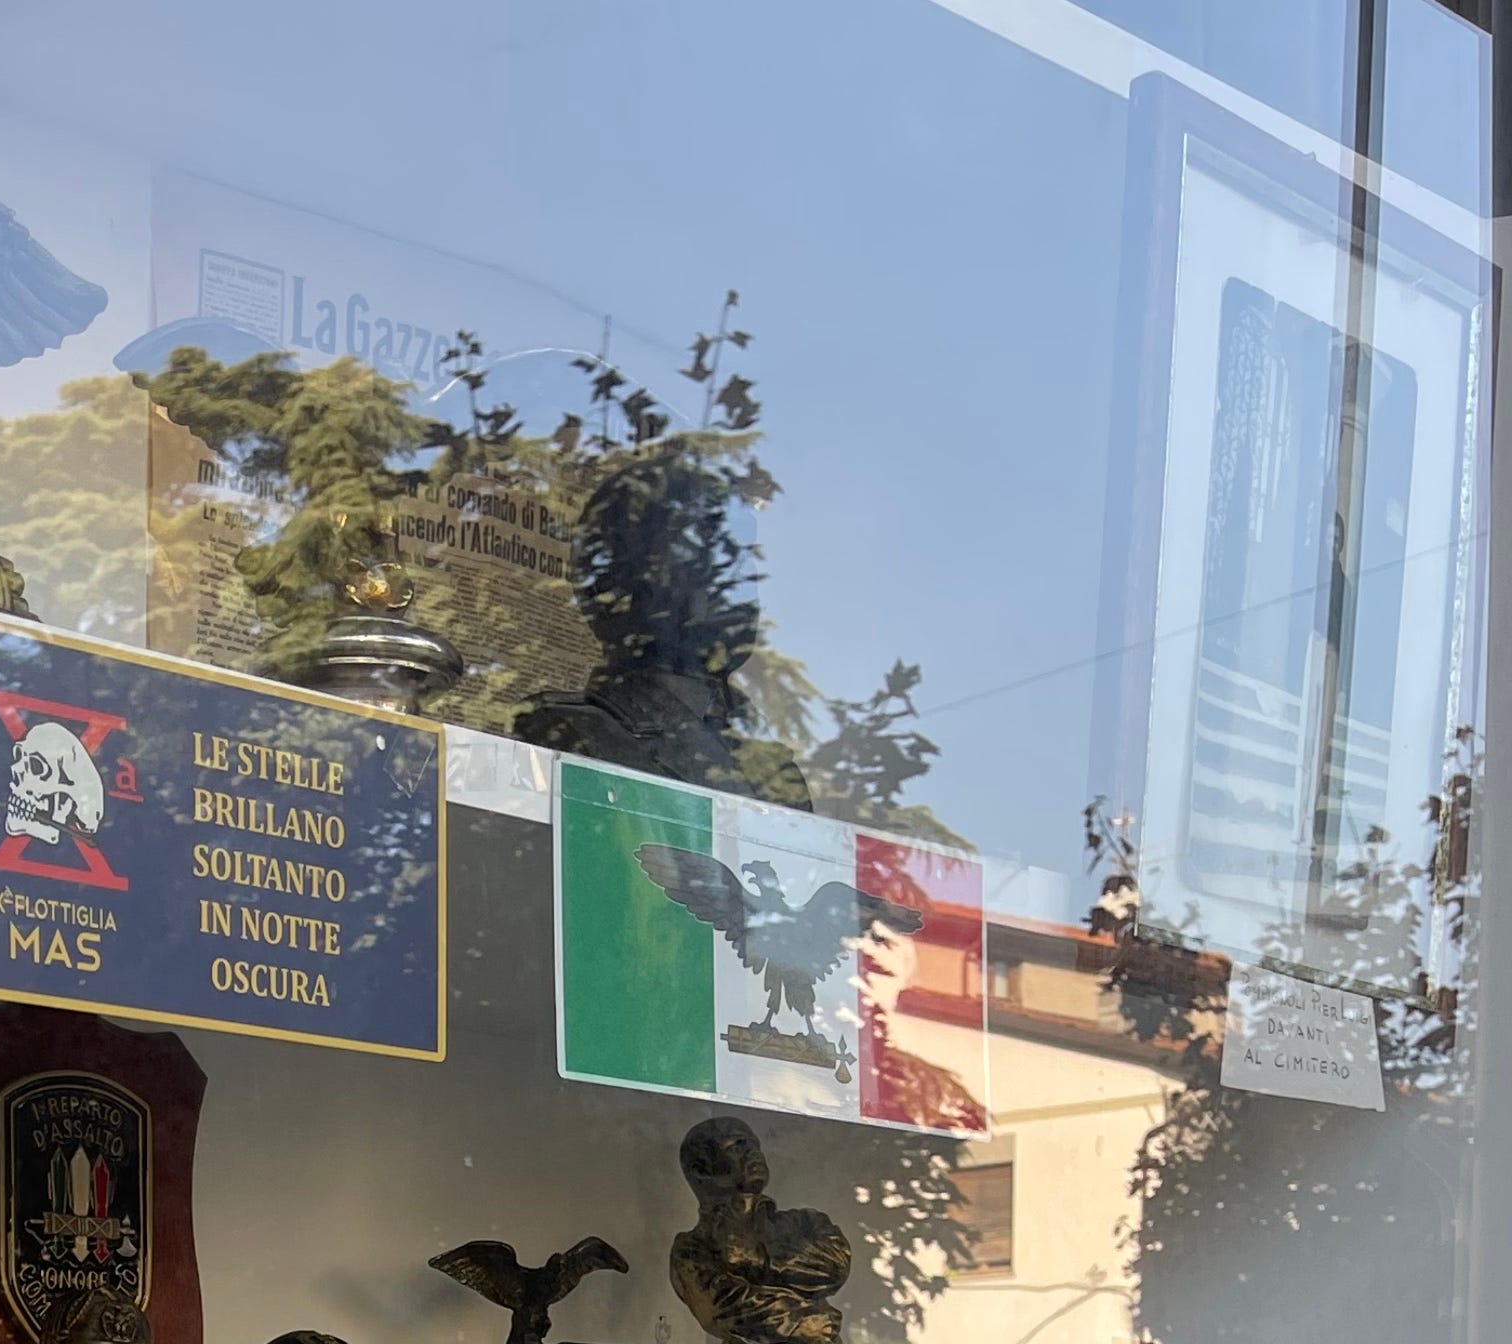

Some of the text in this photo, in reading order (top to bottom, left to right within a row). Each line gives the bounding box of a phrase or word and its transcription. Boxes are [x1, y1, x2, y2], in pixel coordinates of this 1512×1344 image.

[290, 276, 337, 356] La
[522, 503, 535, 528] di
[461, 519, 563, 579] l'Atlantico con
[193, 732, 344, 795] LE STELLE
[193, 788, 345, 848] BRILLANO
[193, 844, 345, 902] SOLTANTO
[15, 894, 117, 931] FLOTTIGLIA
[200, 899, 341, 955] IN NOTTE
[9, 921, 101, 972] MAS
[212, 957, 330, 1007] OSCURA
[1244, 1048, 1350, 1080] AL CIMITERO
[49, 1096, 122, 1127] REPARTO
[33, 1118, 124, 1157] D'ASSALTO
